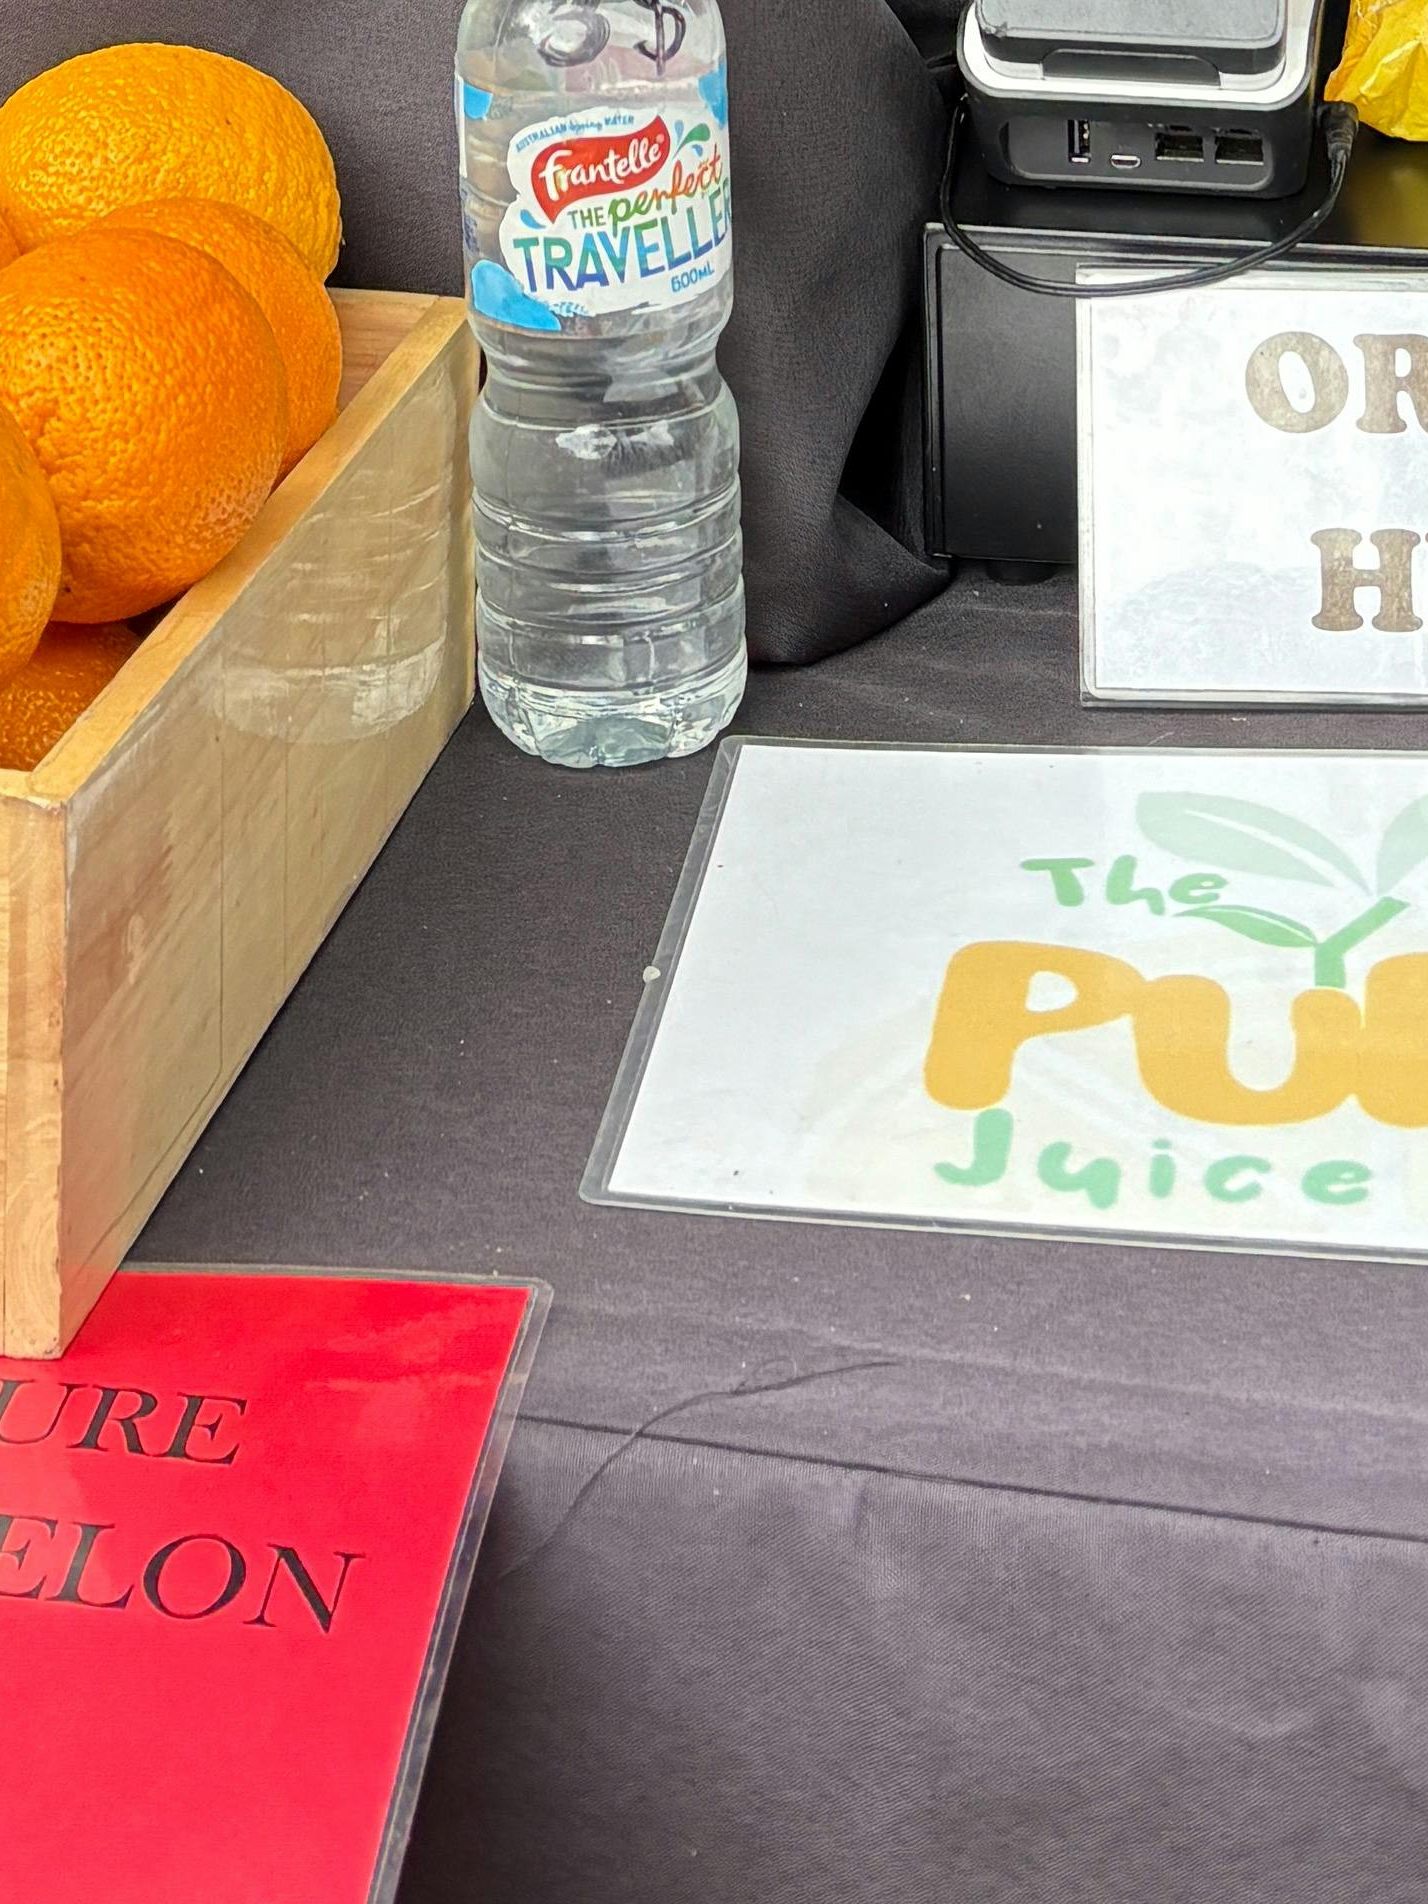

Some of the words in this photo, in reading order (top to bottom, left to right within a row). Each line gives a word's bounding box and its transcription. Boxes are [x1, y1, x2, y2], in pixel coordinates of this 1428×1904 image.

[568, 206, 607, 229] THE
[607, 142, 723, 239] perfect
[1018, 853, 1230, 916] The
[934, 1107, 1374, 1212] Juice
